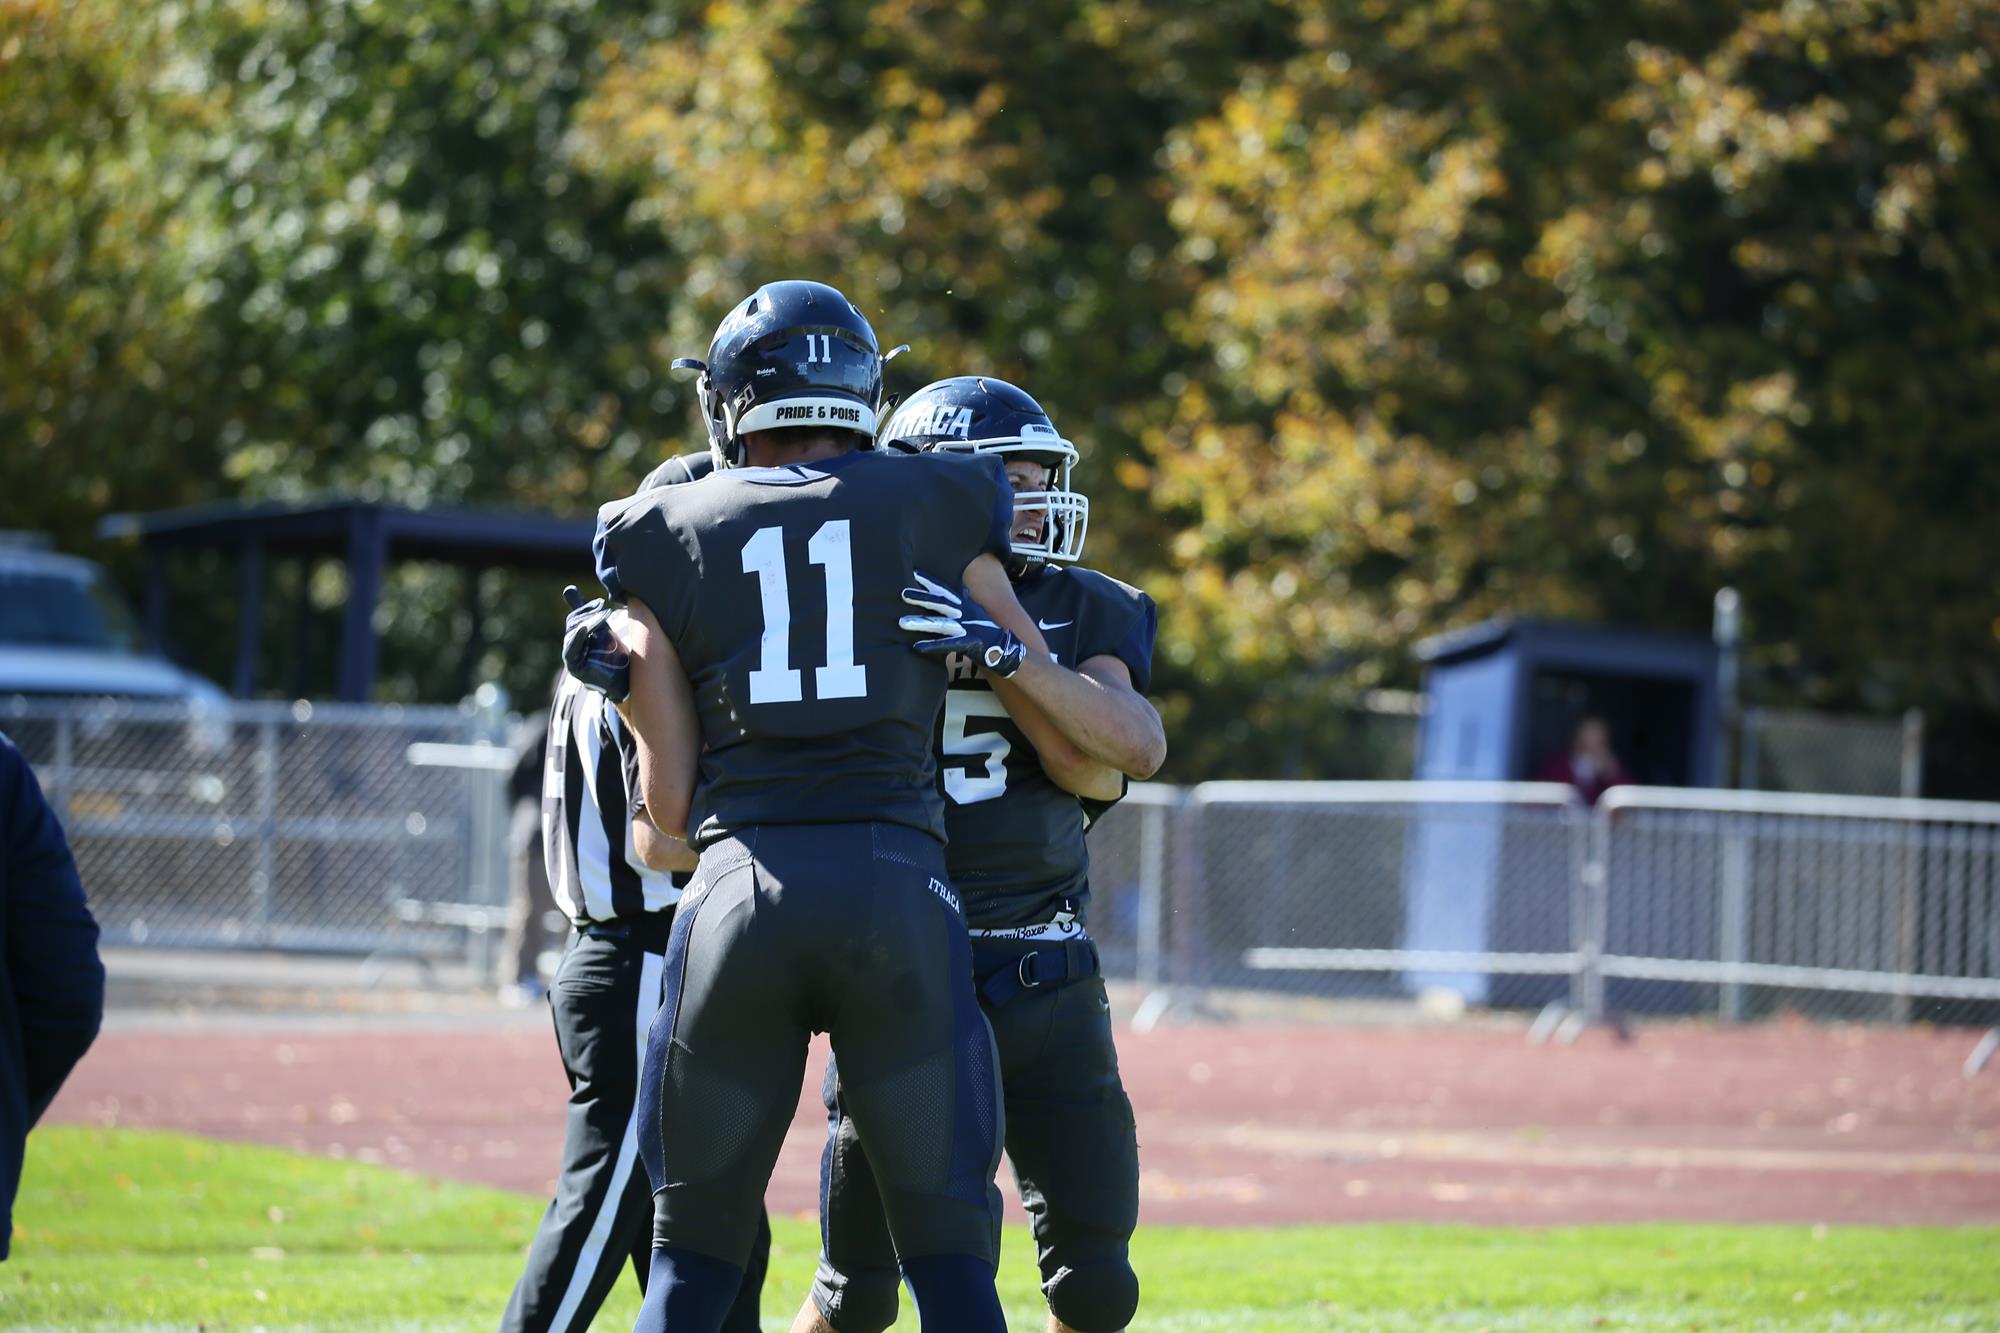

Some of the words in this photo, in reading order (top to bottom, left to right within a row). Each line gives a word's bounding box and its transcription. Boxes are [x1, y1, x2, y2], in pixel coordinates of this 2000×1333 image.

[806, 334, 831, 363] 11
[776, 406, 813, 420] PRIDE
[818, 406, 826, 418] &
[830, 406, 860, 422] POISE
[741, 519, 867, 704] 11
[943, 689, 1012, 804] 5
[928, 877, 960, 914] ITHACA
[1065, 899, 1072, 910] L
